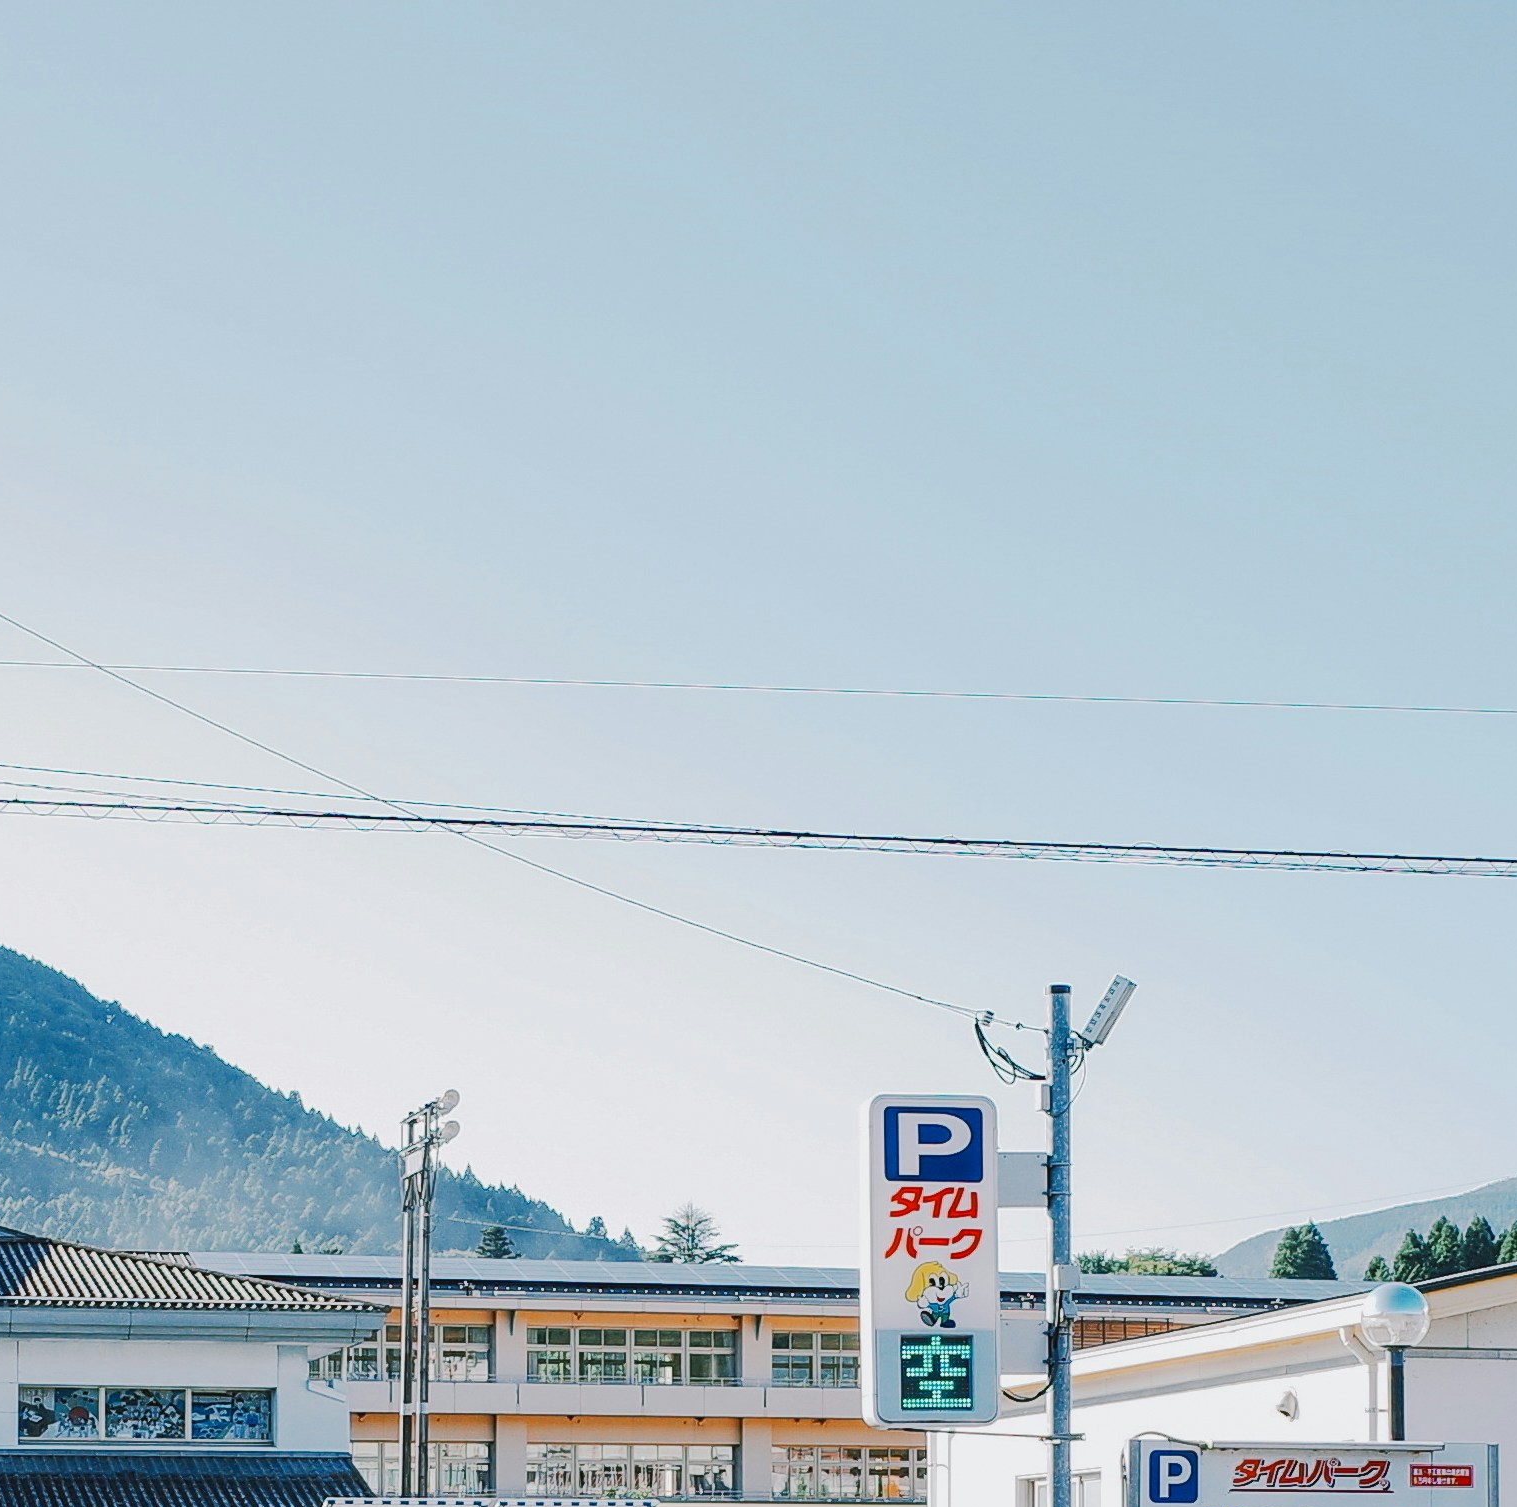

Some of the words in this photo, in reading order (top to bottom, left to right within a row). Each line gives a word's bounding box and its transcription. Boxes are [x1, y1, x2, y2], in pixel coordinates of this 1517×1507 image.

[897, 1112, 972, 1177] P
[889, 1186, 980, 1219] タイム
[884, 1225, 983, 1260] パーク
[901, 1335, 973, 1410] 空
[1159, 1455, 1193, 1499] P
[1231, 1458, 1392, 1490] タイムパーク
